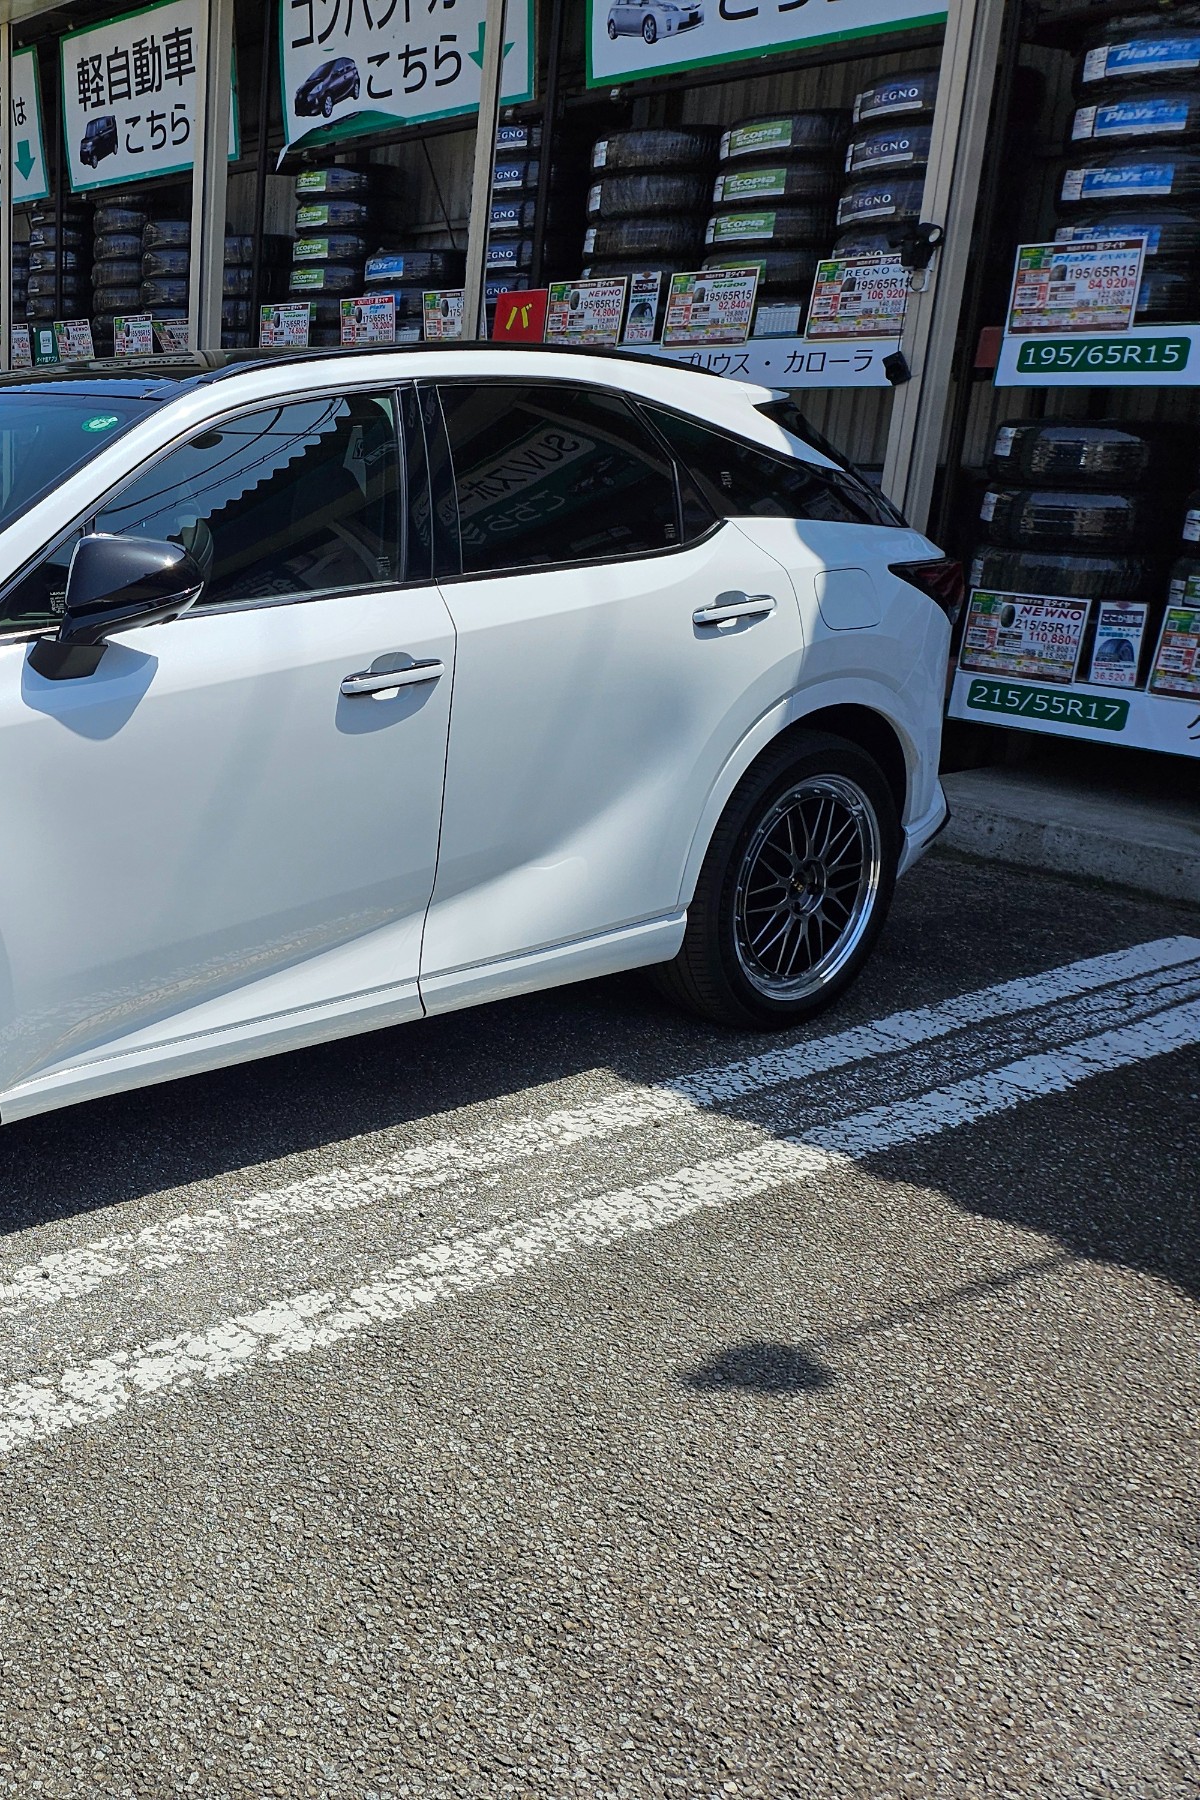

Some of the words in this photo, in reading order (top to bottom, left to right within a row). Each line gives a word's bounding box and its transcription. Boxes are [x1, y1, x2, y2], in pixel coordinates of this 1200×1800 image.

[76, 26, 196, 113] 軽自動車
[366, 35, 462, 100] こちら
[873, 87, 919, 104] REGNO
[124, 103, 191, 155] こちら
[865, 139, 910, 157] REGNO
[851, 194, 892, 210] REGNO
[845, 267, 890, 277] REGNO
[1069, 265, 1136, 279] 195/65R15
[588, 289, 621, 297] NEWNO
[704, 290, 752, 302] 195/65R15
[580, 299, 621, 310] 195/65R15
[363, 314, 393, 323] 175/65R15
[1023, 344, 1181, 367] 195/65R15
[1020, 606, 1082, 620] NEWNO
[1014, 619, 1080, 635] 215/55R17
[973, 686, 1120, 722] 215/55R17
